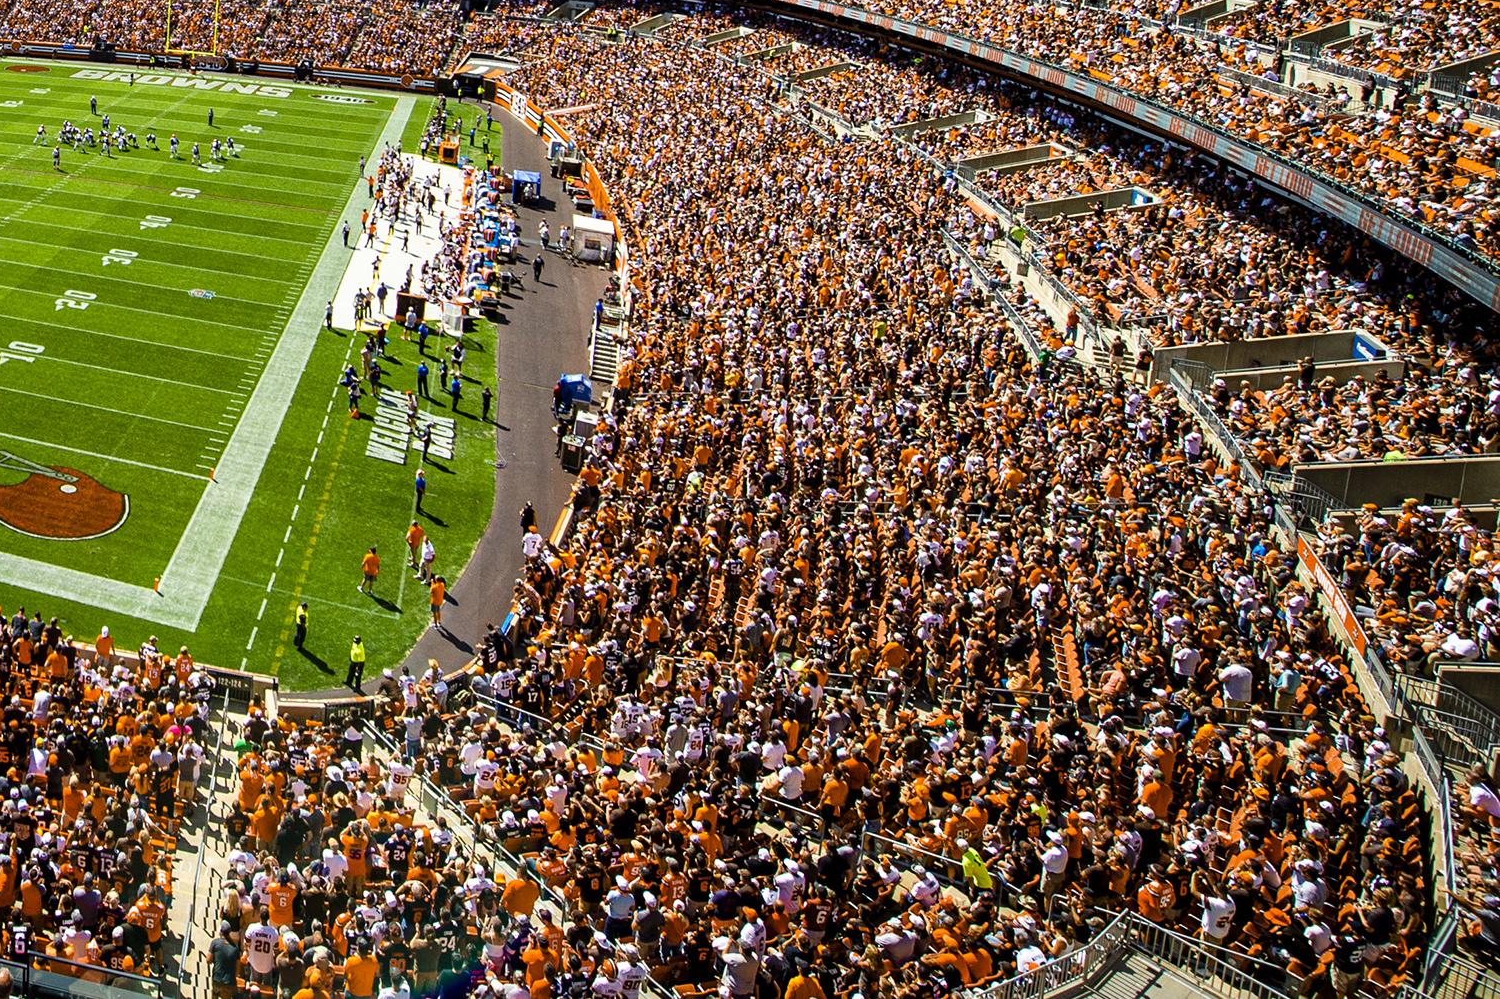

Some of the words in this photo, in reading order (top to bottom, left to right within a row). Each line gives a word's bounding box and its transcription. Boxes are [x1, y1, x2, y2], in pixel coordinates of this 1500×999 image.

[69, 70, 293, 99] BROWNS
[1255, 156, 1279, 180] GET
[171, 187, 200, 200] 50
[145, 215, 171, 230] 40
[105, 248, 138, 265] 30
[64, 289, 97, 310] 20
[3, 339, 45, 362] 10
[365, 388, 411, 465] WELCOME
[411, 409, 455, 460] BACK
[218, 677, 241, 688] 122-124
[255, 940, 270, 953] 20
